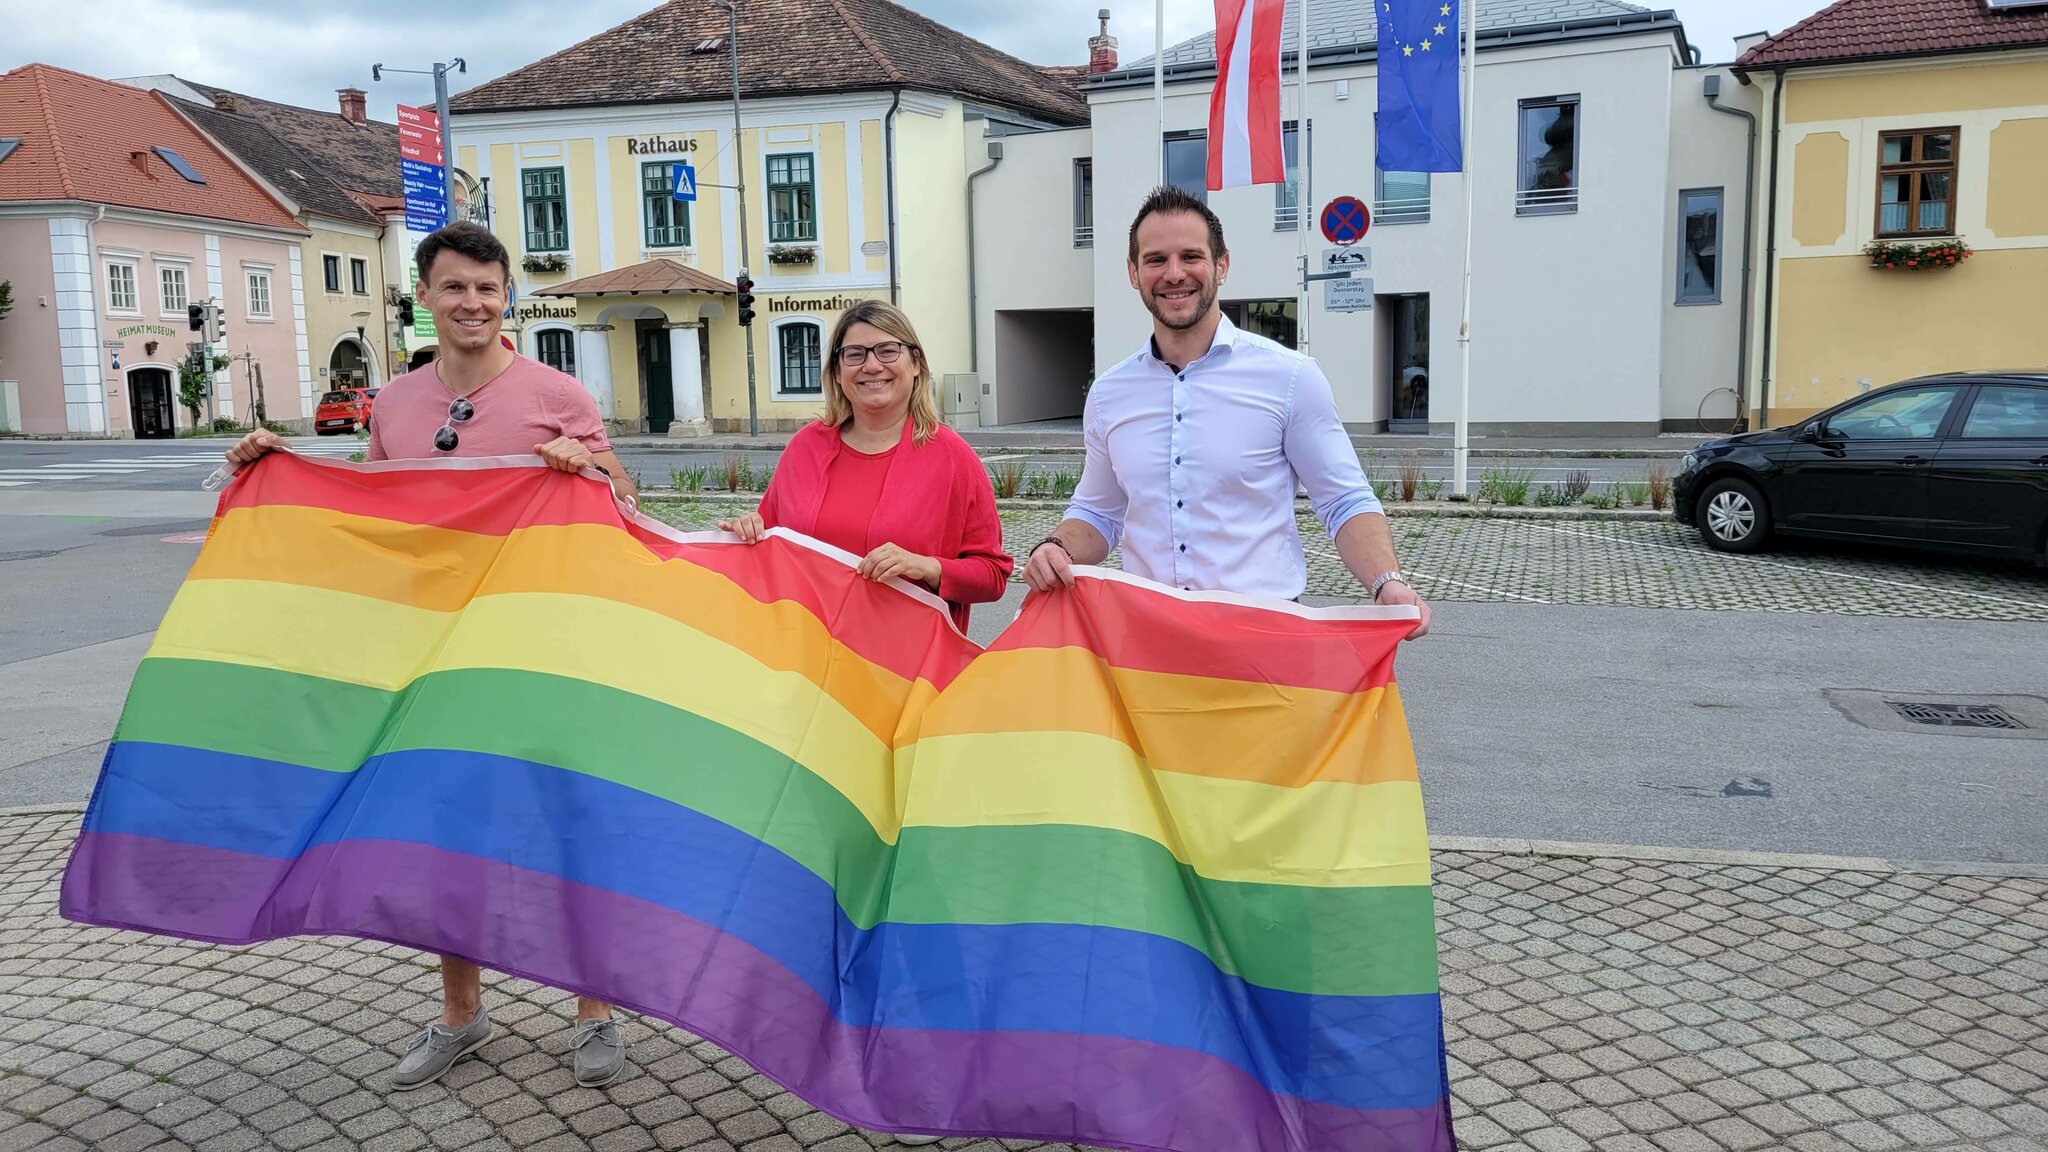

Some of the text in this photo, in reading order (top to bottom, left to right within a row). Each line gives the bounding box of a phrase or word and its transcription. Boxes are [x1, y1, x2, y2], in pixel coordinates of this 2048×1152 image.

[399, 109, 420, 121] Sportplatz
[400, 128, 422, 138] Feuerwehr
[402, 146, 419, 155] Friedhof
[627, 135, 698, 155] Rathaus
[1327, 263, 1367, 271] Abschleppzone
[117, 325, 176, 339] HEIMAT MUSEUM
